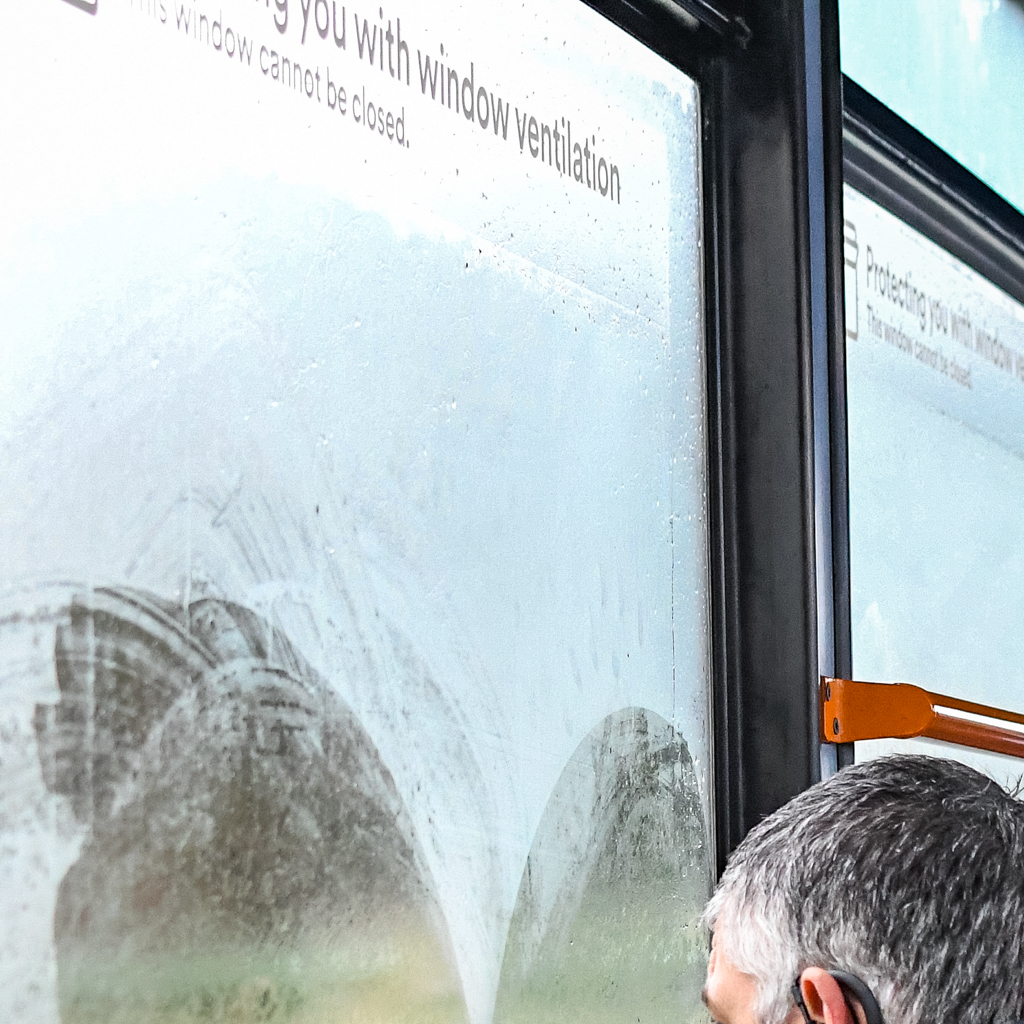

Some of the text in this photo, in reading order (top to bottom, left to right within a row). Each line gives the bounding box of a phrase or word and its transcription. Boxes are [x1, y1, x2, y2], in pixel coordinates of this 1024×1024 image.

[174, 0, 253, 67] window
[259, 45, 321, 104] cannot
[326, 66, 348, 117] be
[352, 85, 410, 149] closed.
[301, 0, 621, 205] you with window ventilation
[866, 244, 926, 333] Protecting
[927, 295, 949, 338] you
[866, 302, 884, 339] This
